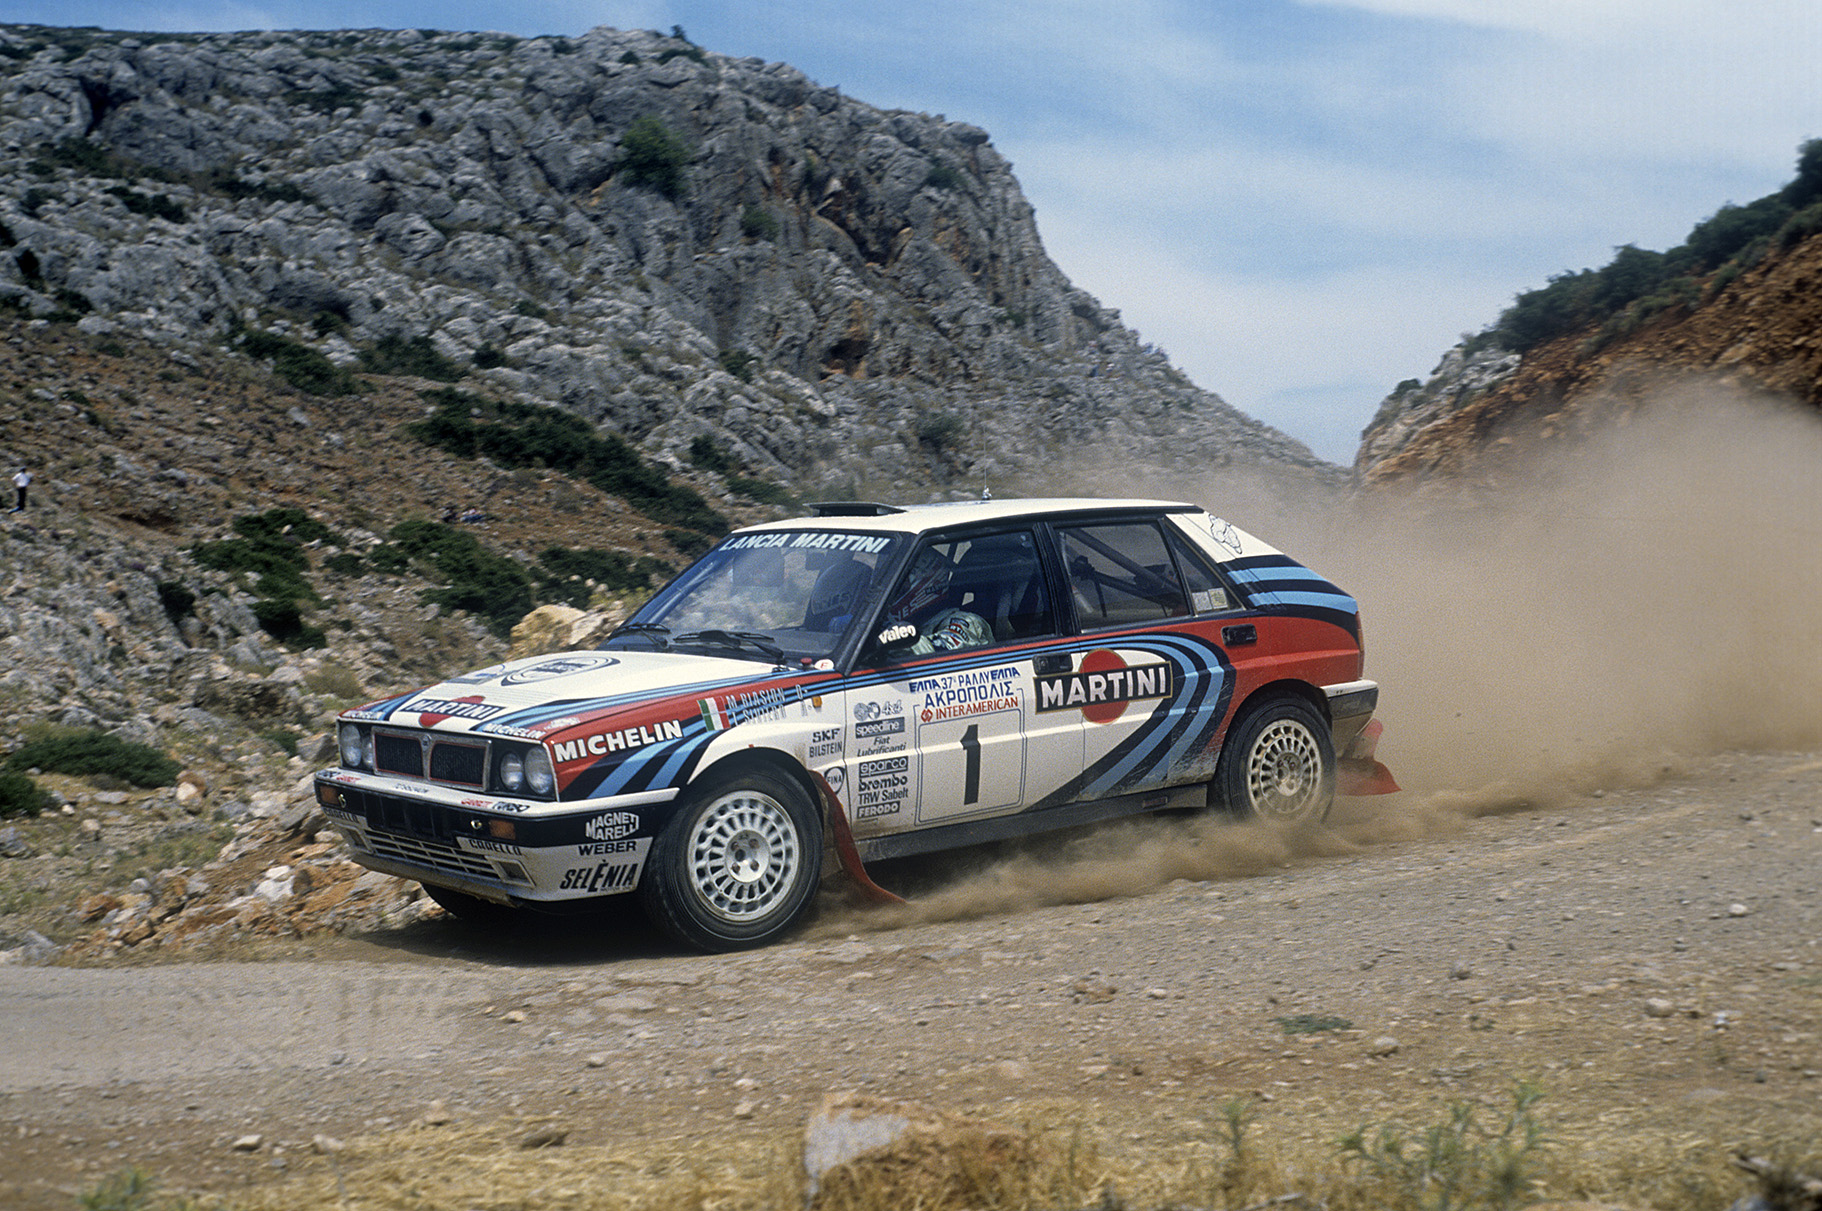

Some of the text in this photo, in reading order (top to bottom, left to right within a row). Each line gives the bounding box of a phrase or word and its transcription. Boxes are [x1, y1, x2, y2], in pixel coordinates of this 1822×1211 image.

[718, 533, 891, 553] LANCIA MARTINI
[878, 624, 917, 645] valeo
[924, 681, 1014, 709] ΑΚΡΟΠΟΛΙΣ
[1040, 665, 1167, 710] MARTINI
[740, 687, 786, 708] BIASION
[406, 700, 496, 719] MARTINI
[935, 696, 1019, 720] INTERAMERICAN
[482, 722, 547, 739] MICHELIN
[812, 727, 840, 743] SKF
[553, 719, 684, 764] MICHELIN
[809, 741, 843, 758] BILSTEIN
[857, 742, 907, 757] Lubrificanti
[873, 736, 891, 746] Fiat
[959, 724, 981, 805] 1
[859, 774, 908, 792] brembo
[858, 787, 909, 805] TRW Sabelt
[858, 803, 899, 818] FERODO
[578, 841, 637, 856] WEBER
